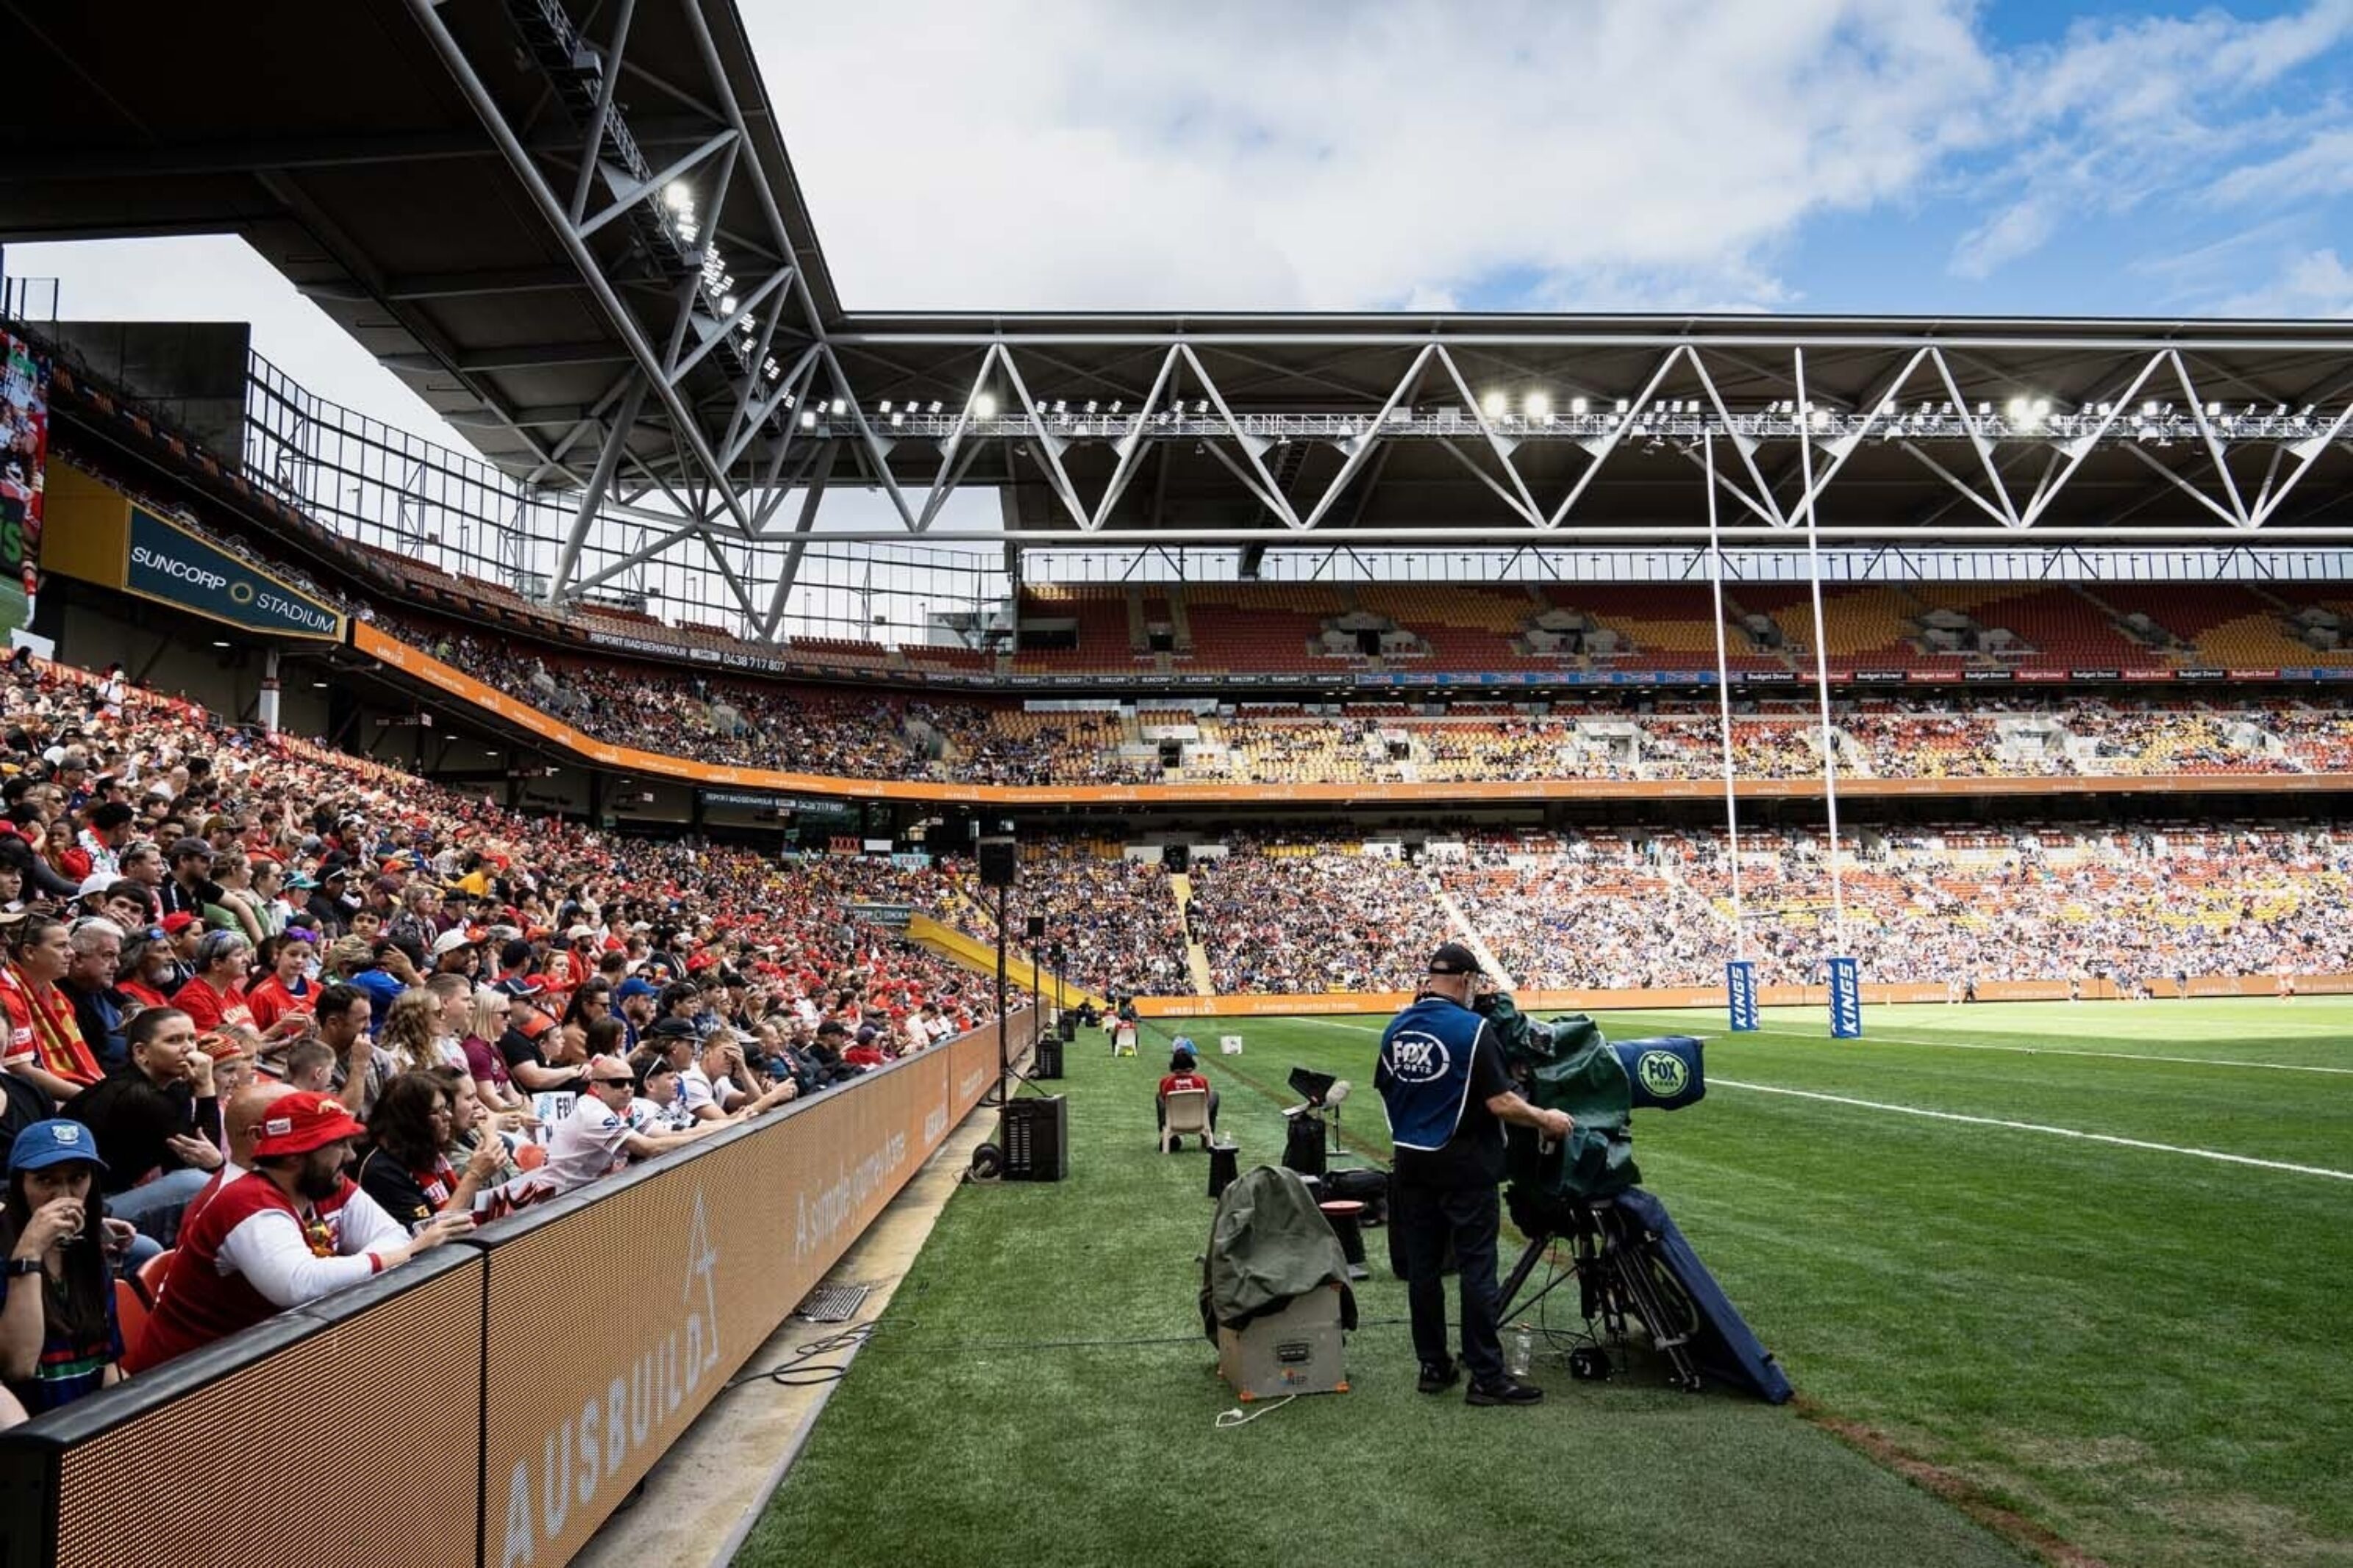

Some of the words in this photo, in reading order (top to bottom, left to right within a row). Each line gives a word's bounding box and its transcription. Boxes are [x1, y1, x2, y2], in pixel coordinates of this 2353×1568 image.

[131, 546, 226, 590] SUNCORP
[257, 593, 335, 633] STADIUM
[590, 633, 624, 647] REPORT
[624, 637, 642, 650] BAD
[643, 642, 687, 657] BEHAVIOUR
[724, 653, 747, 667] 0438
[749, 656, 767, 670] 717
[768, 659, 787, 672] 807
[1748, 673, 1771, 681] Budget
[1731, 965, 1748, 1028] KINGS
[1839, 962, 1858, 1034] KINGS
[1391, 1040, 1434, 1067] FOX
[1647, 1059, 1679, 1081] FOX
[503, 1312, 702, 1568] AUSBUILD
